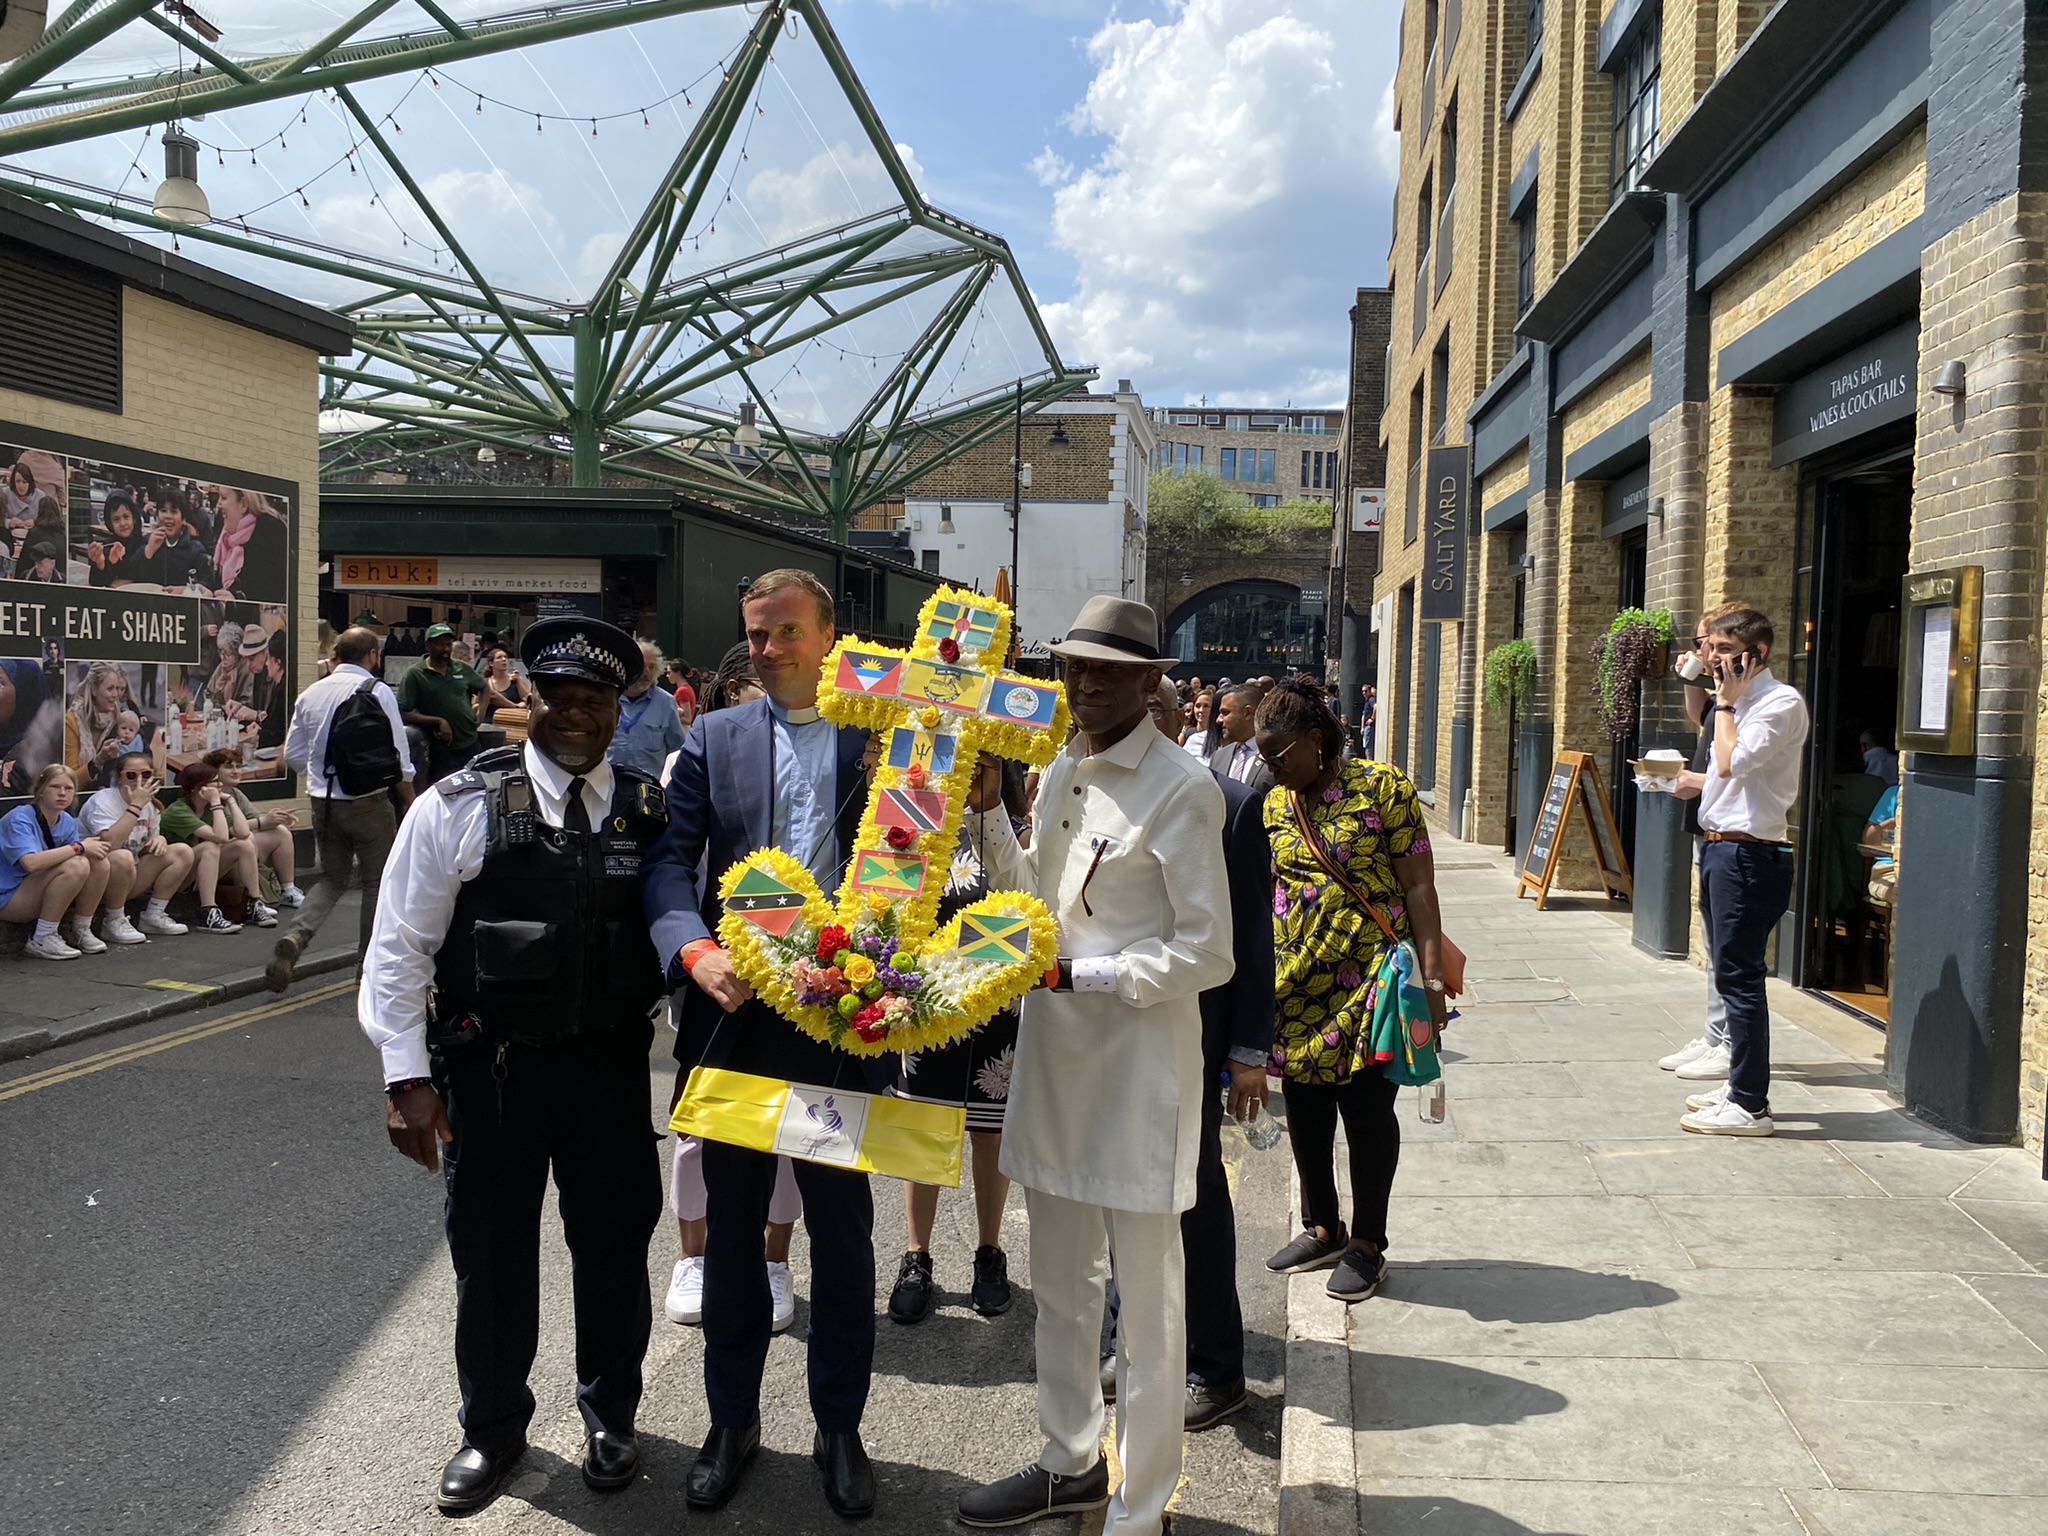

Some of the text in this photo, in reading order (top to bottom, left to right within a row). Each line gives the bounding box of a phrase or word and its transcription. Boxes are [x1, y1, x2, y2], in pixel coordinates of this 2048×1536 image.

[1830, 359, 1882, 399] TAPAS BAR
[1809, 374, 1906, 433] WINES & COCKTAILS
[1431, 475, 1457, 592] SALT YARD
[447, 577, 588, 590] tel aviv market food
[65, 606, 107, 640] EAT
[122, 609, 188, 645] SHARE
[1018, 637, 1050, 656] ake
